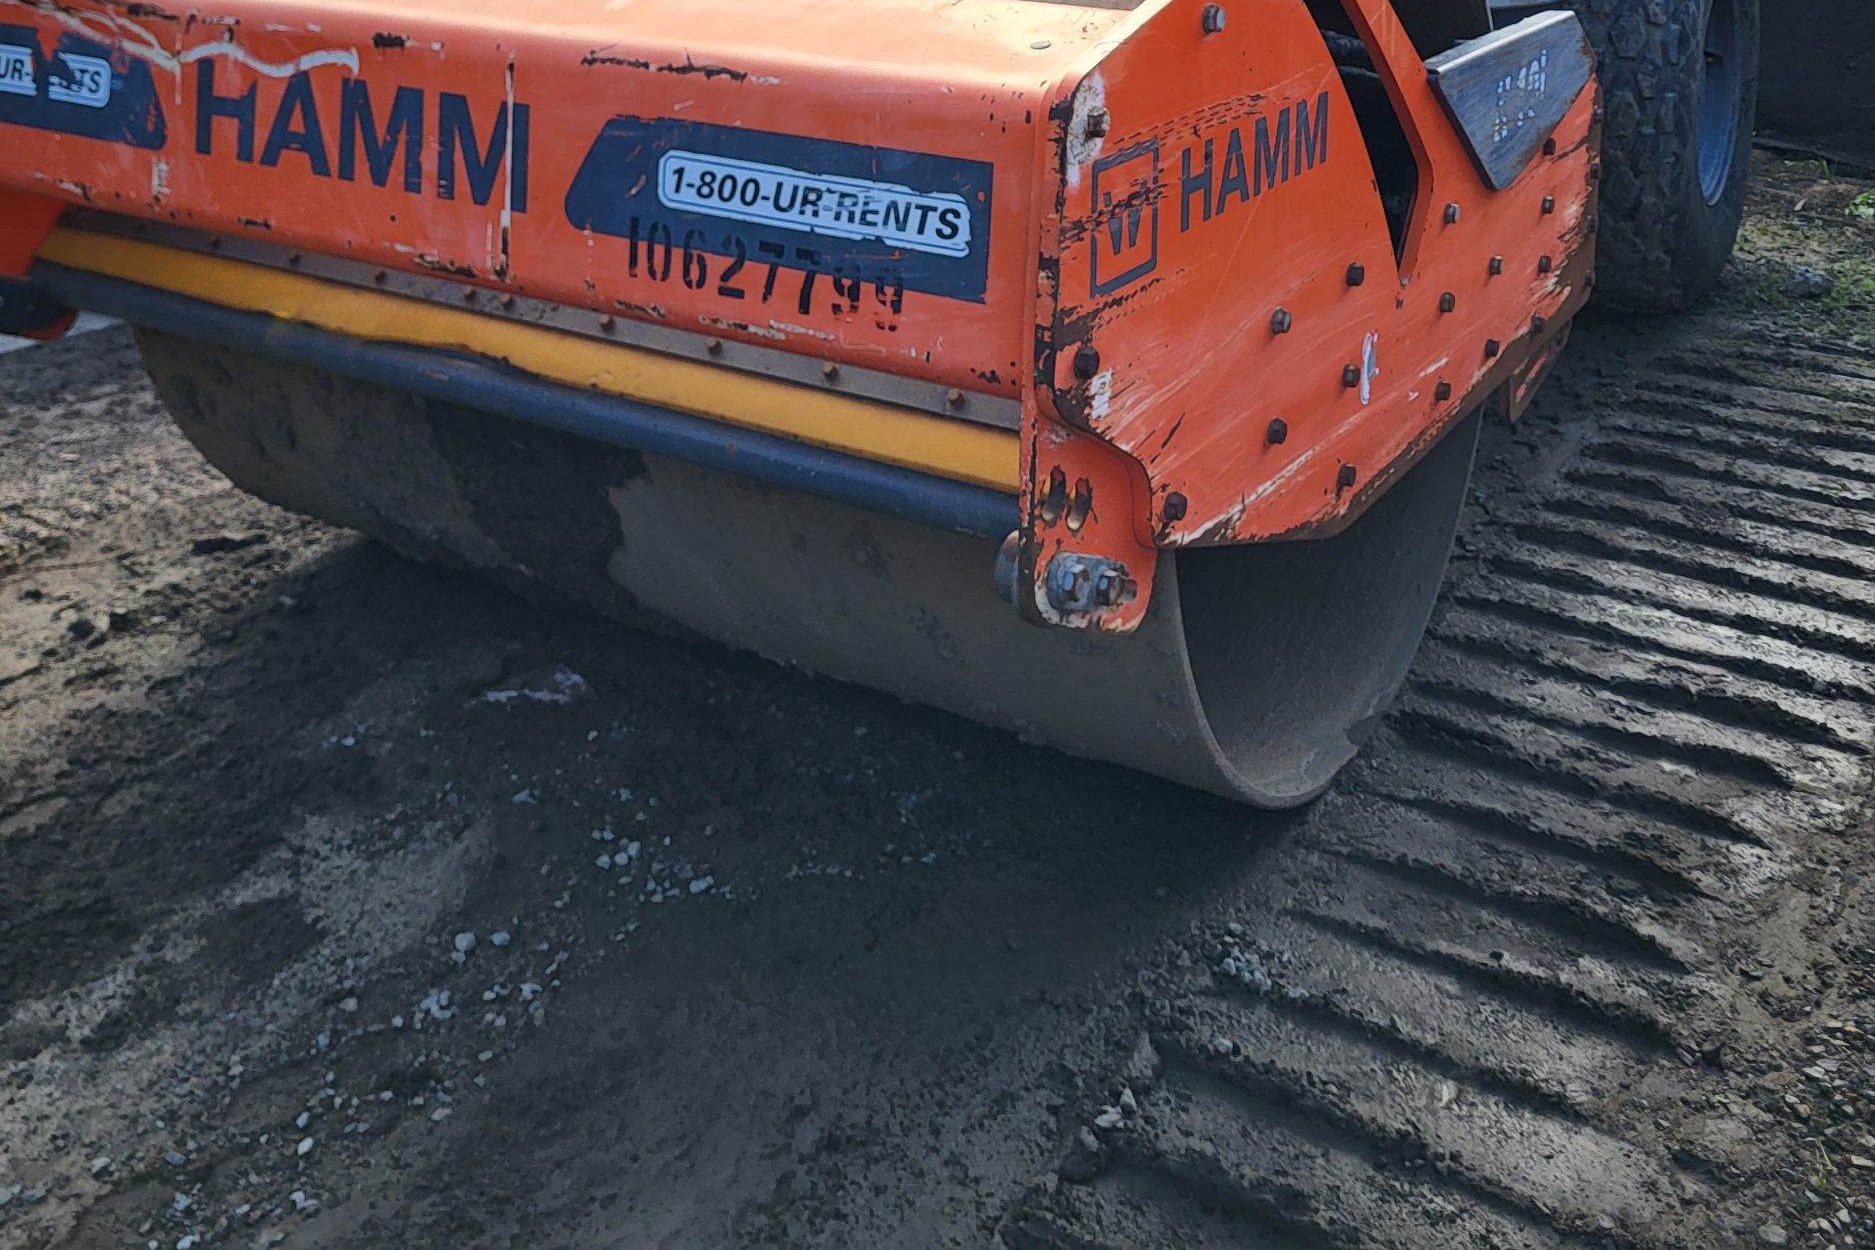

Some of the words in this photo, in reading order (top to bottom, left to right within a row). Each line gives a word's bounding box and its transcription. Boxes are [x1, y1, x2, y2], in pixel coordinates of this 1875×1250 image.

[195, 58, 530, 213] HAMM
[670, 165, 963, 240] 1-800-UR-RENTS
[1180, 90, 1329, 232] HAMM
